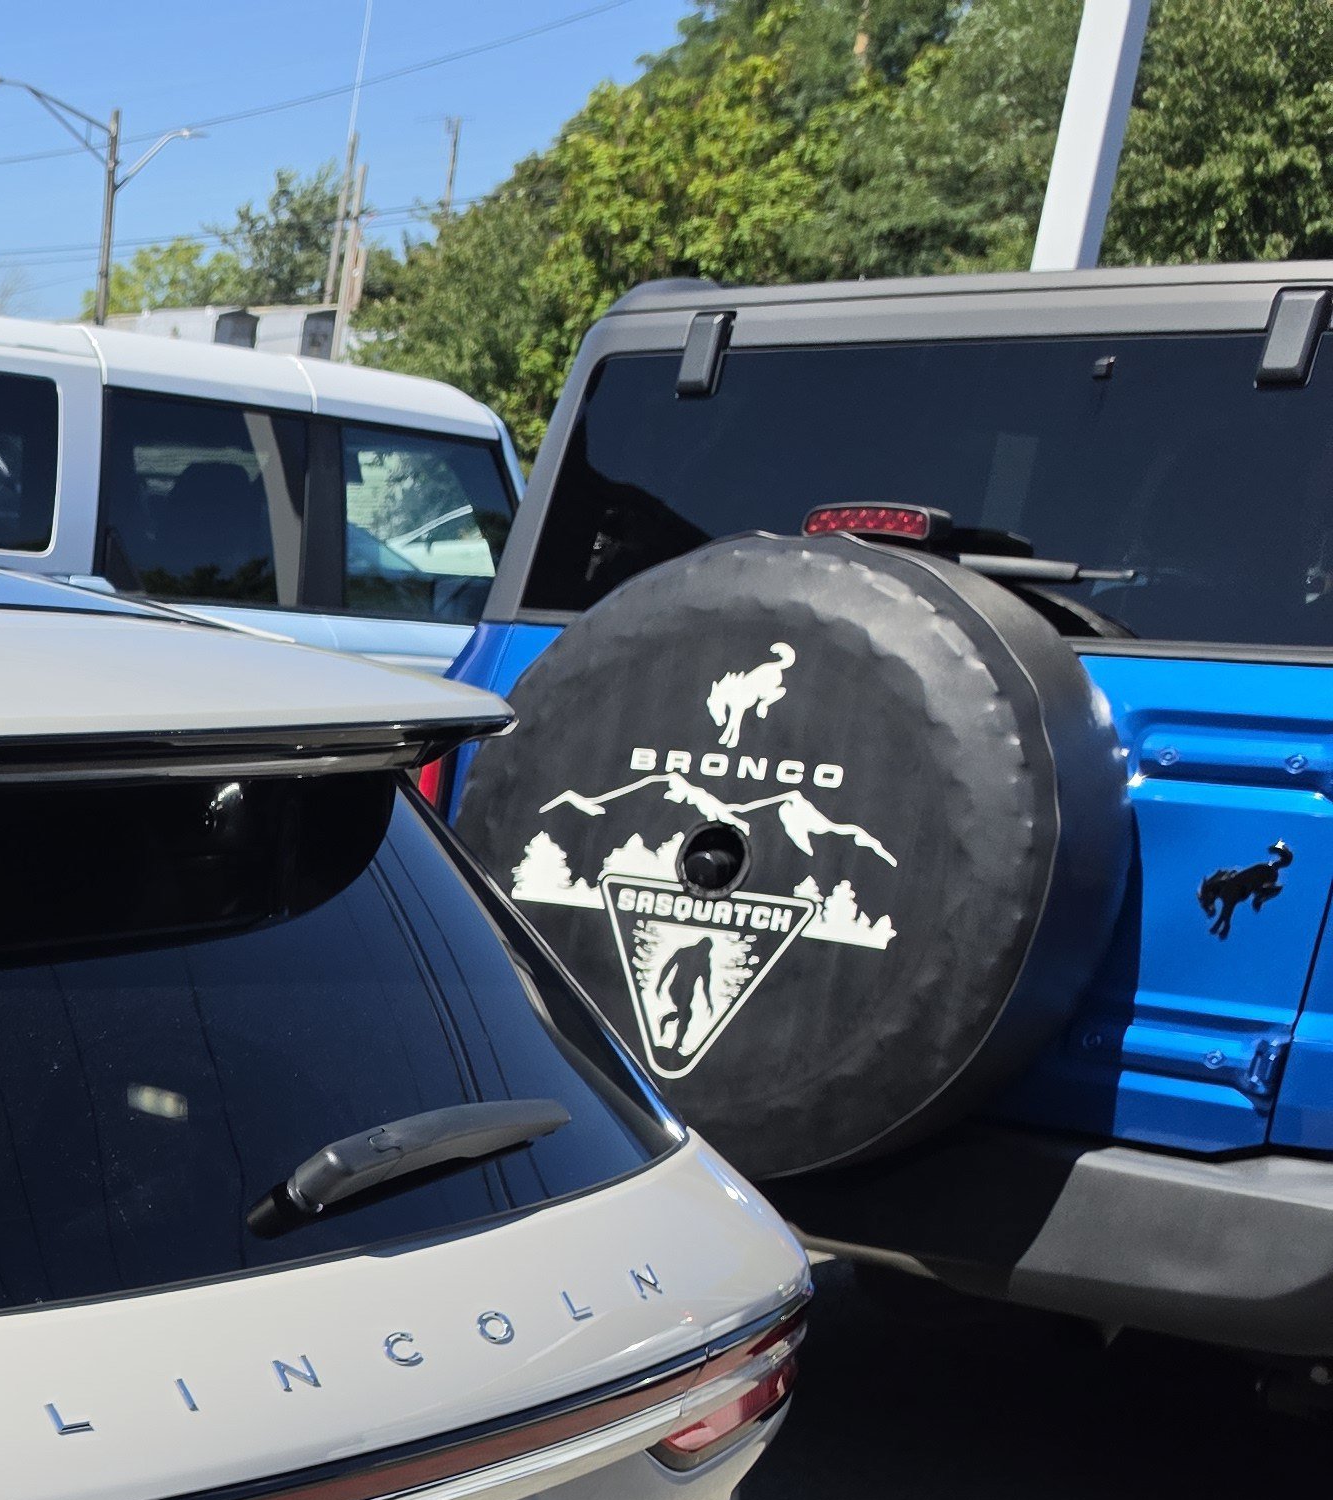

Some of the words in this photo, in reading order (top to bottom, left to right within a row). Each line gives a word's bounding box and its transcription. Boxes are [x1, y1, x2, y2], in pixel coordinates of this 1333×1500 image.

[629, 747, 844, 789] BRONCO
[617, 888, 793, 933] SASQUATCH
[44, 1262, 663, 1436] LINCOLN
